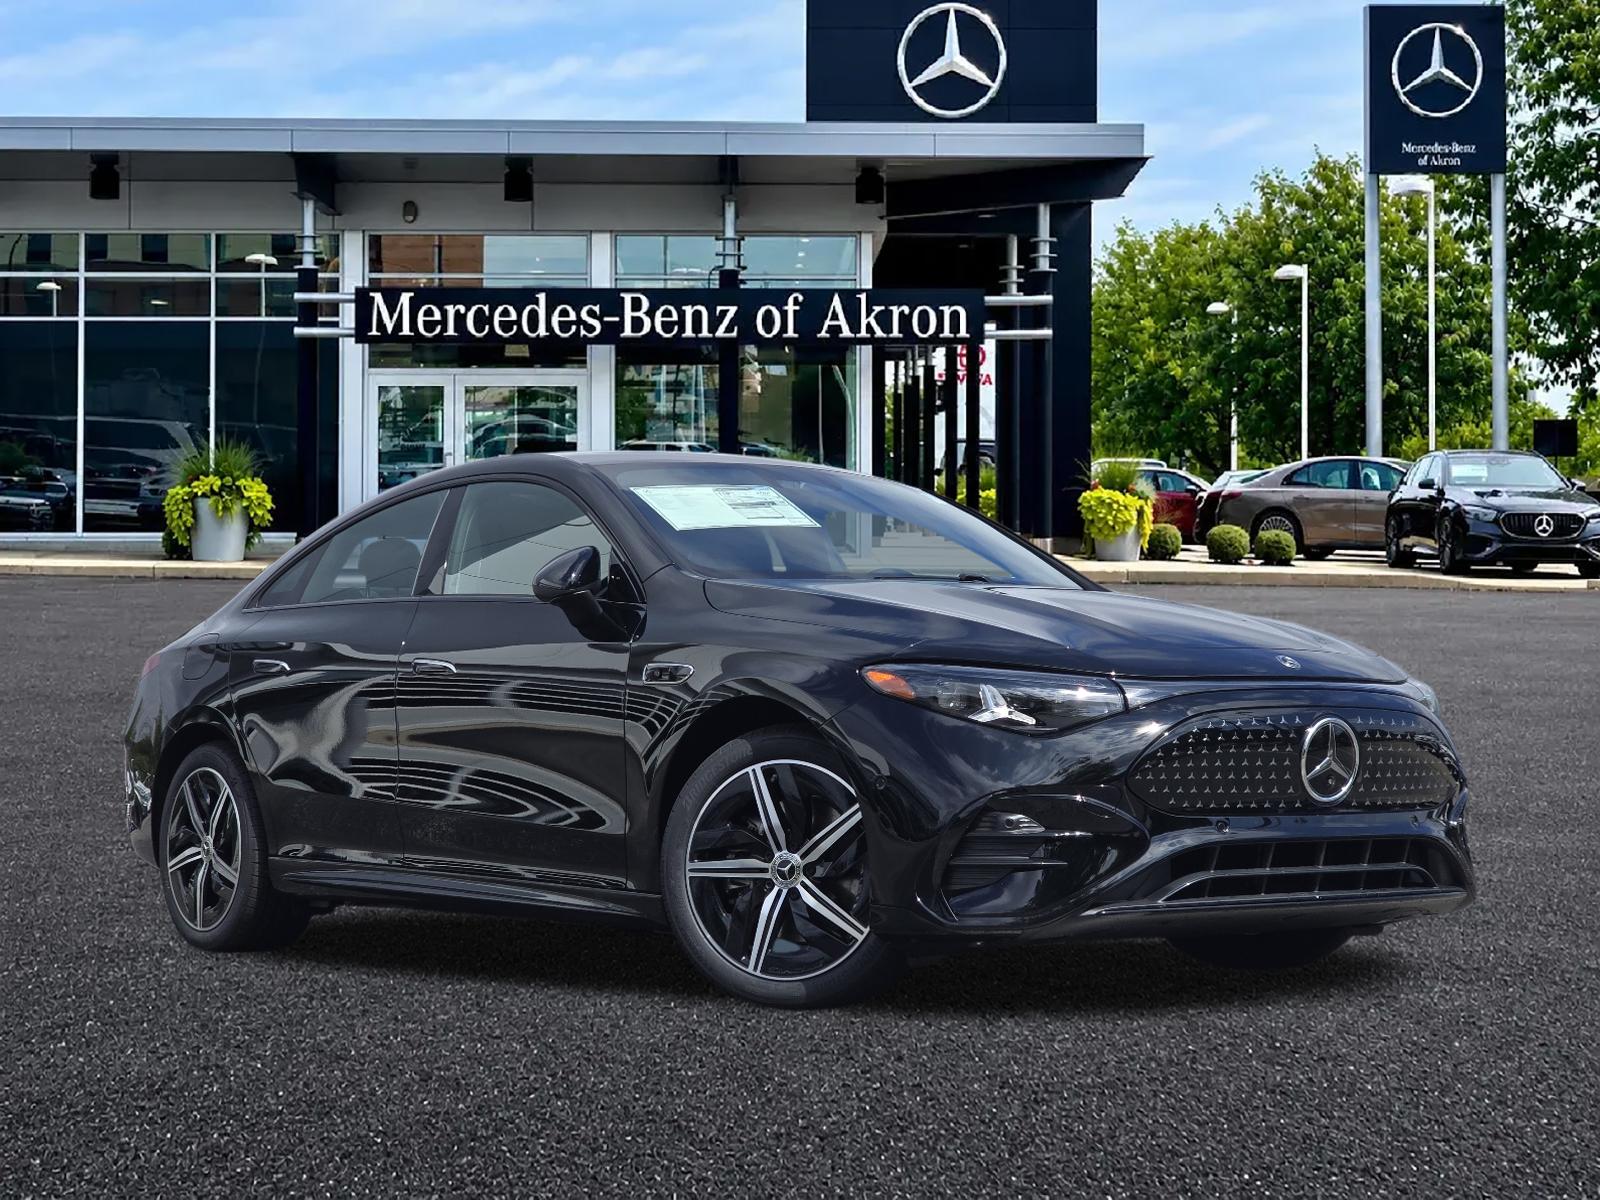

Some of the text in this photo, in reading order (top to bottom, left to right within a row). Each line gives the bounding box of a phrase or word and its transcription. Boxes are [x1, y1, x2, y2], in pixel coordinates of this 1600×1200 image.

[1401, 142, 1477, 154] Mercedes-Benz
[1417, 154, 1461, 166] of Akron
[367, 291, 971, 338] Mercedes-Benz of Akron
